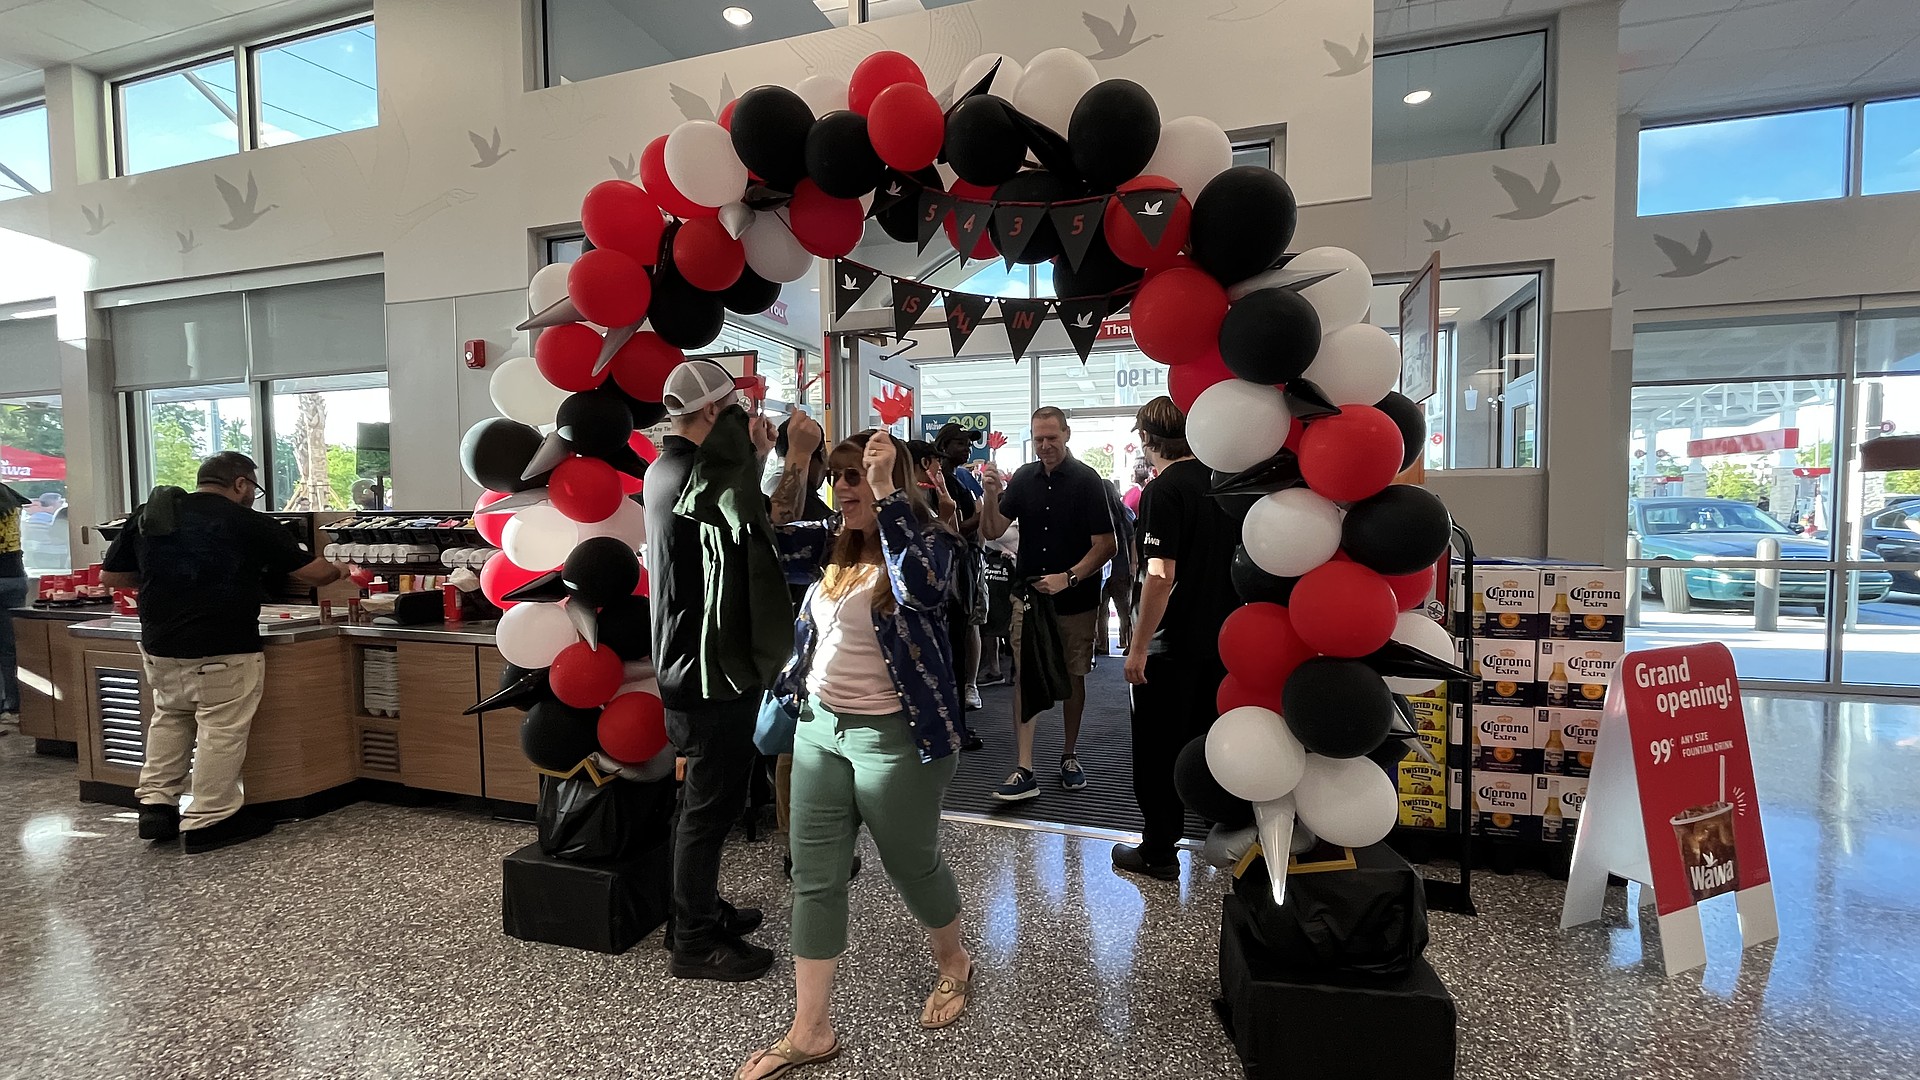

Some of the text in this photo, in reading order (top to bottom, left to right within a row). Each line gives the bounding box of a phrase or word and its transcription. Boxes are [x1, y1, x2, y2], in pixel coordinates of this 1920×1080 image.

[901, 295, 1034, 335] IS ALL IN
[1104, 323, 1132, 335] Tha
[1486, 586, 1535, 601] Corona
[1570, 587, 1621, 602] Corona
[1498, 598, 1523, 606] Extra
[1583, 599, 1608, 607] Extra
[1482, 655, 1531, 669] Corona
[1495, 667, 1519, 675] Extra
[1581, 669, 1606, 677] Extra
[1635, 656, 1691, 688] Grand
[1656, 677, 1733, 718] opening!
[1432, 703, 1444, 712] TEA
[1480, 721, 1529, 735] Corona
[1563, 724, 1599, 739] Coro
[1431, 736, 1443, 745] TEA
[1493, 732, 1517, 741] Extra
[1577, 736, 1597, 745] Extr
[1681, 731, 1709, 745] ANY SIZE
[1682, 740, 1734, 758] FOUNTAIN DRINK
[1401, 767, 1429, 775] TWISTED
[1430, 768, 1442, 778] TEA
[1478, 786, 1527, 801] Corona
[1401, 799, 1430, 807] TWISTED
[1430, 800, 1443, 810] TEA
[1491, 798, 1515, 807] Extra
[1690, 860, 1735, 891] Wawa
